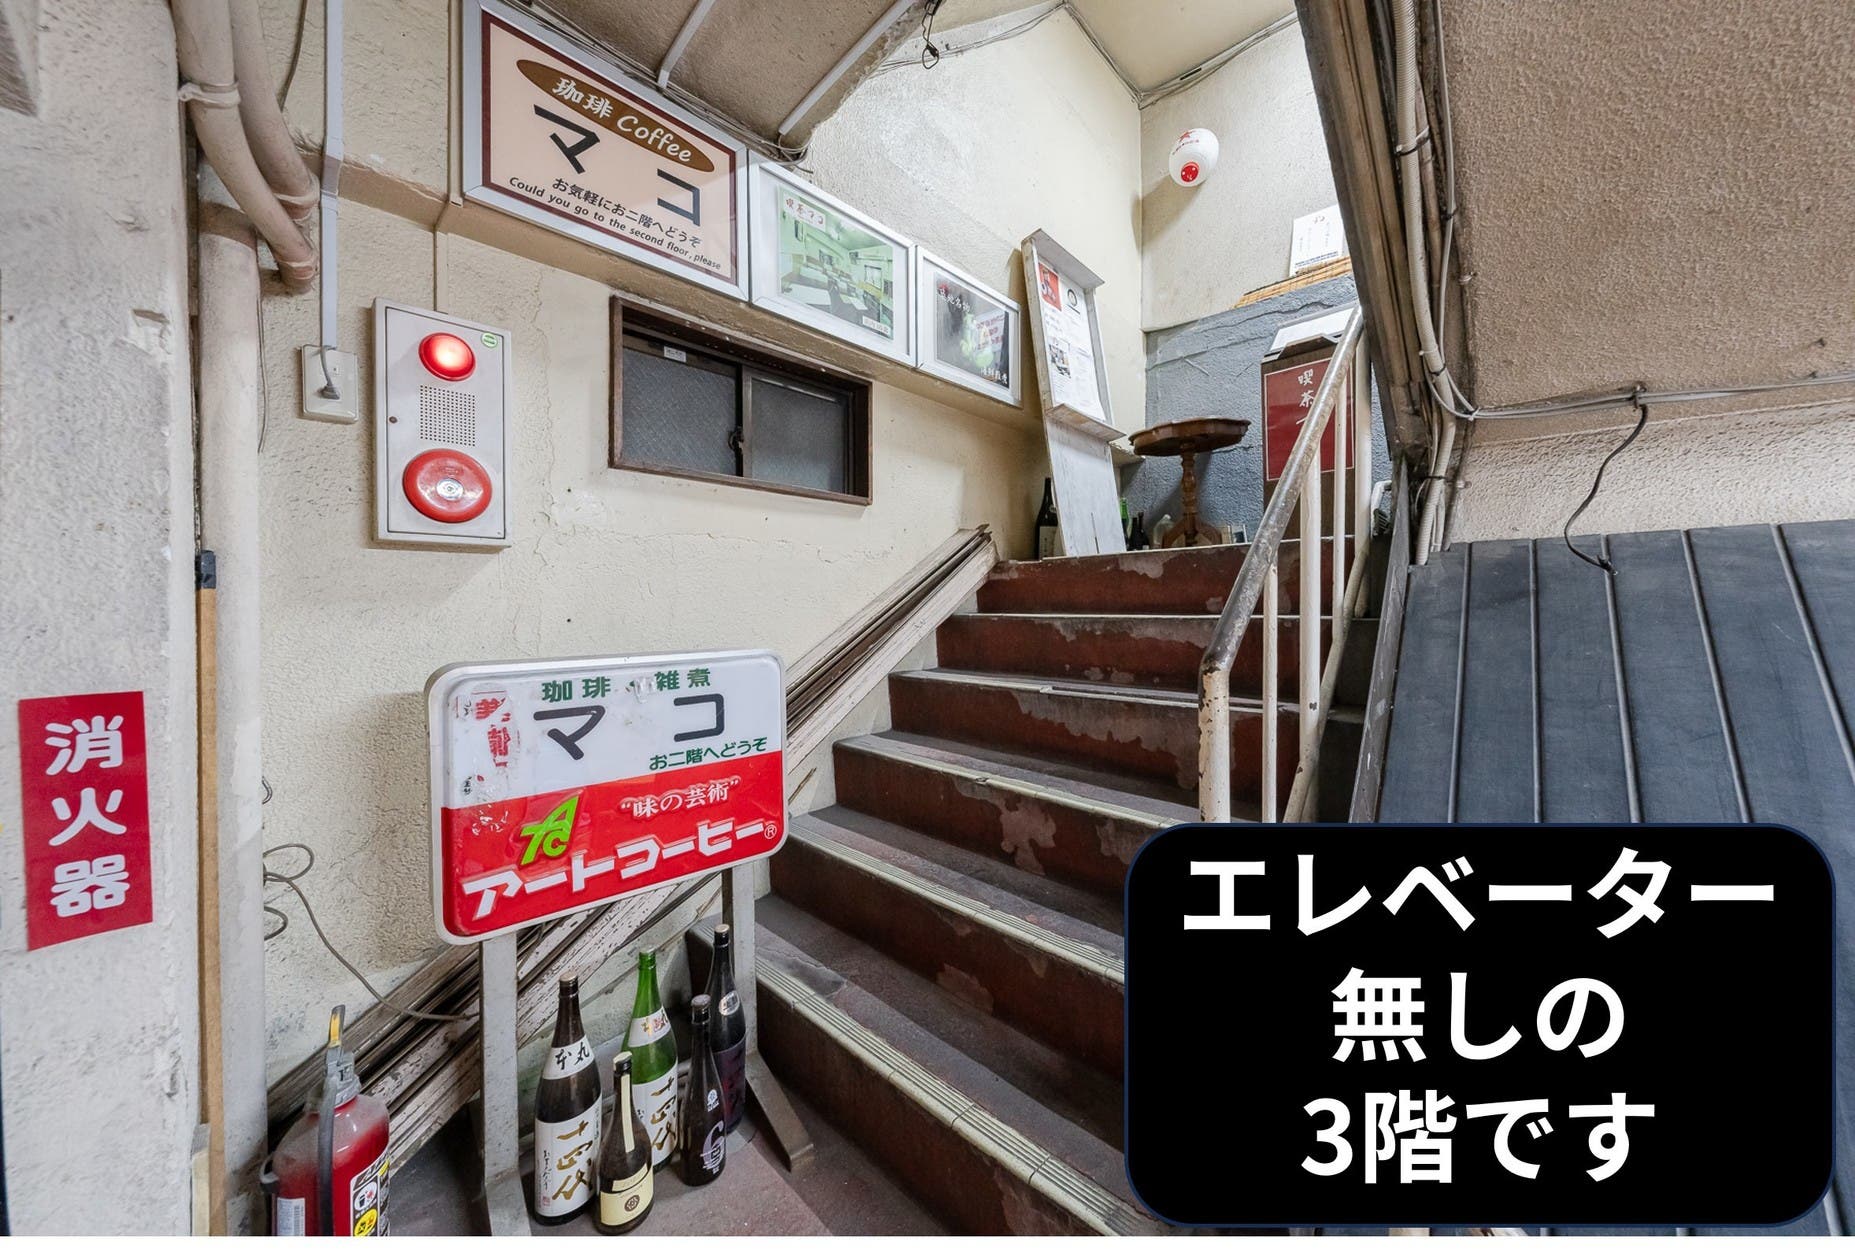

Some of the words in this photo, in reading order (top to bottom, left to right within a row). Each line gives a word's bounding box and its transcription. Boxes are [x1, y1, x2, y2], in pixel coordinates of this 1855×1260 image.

[552, 77, 613, 118] 珈琲
[616, 115, 692, 162] Coffee
[509, 177, 545, 197] Could
[548, 194, 571, 210] you
[574, 205, 589, 217] go
[593, 211, 605, 222] to
[609, 218, 626, 232] the
[630, 226, 664, 247] second
[693, 253, 721, 270] please
[552, 178, 702, 248] お気軽にお二階へどうぞ
[649, 737, 768, 771] お二階へどうぞ
[44, 715, 130, 918] 消火器
